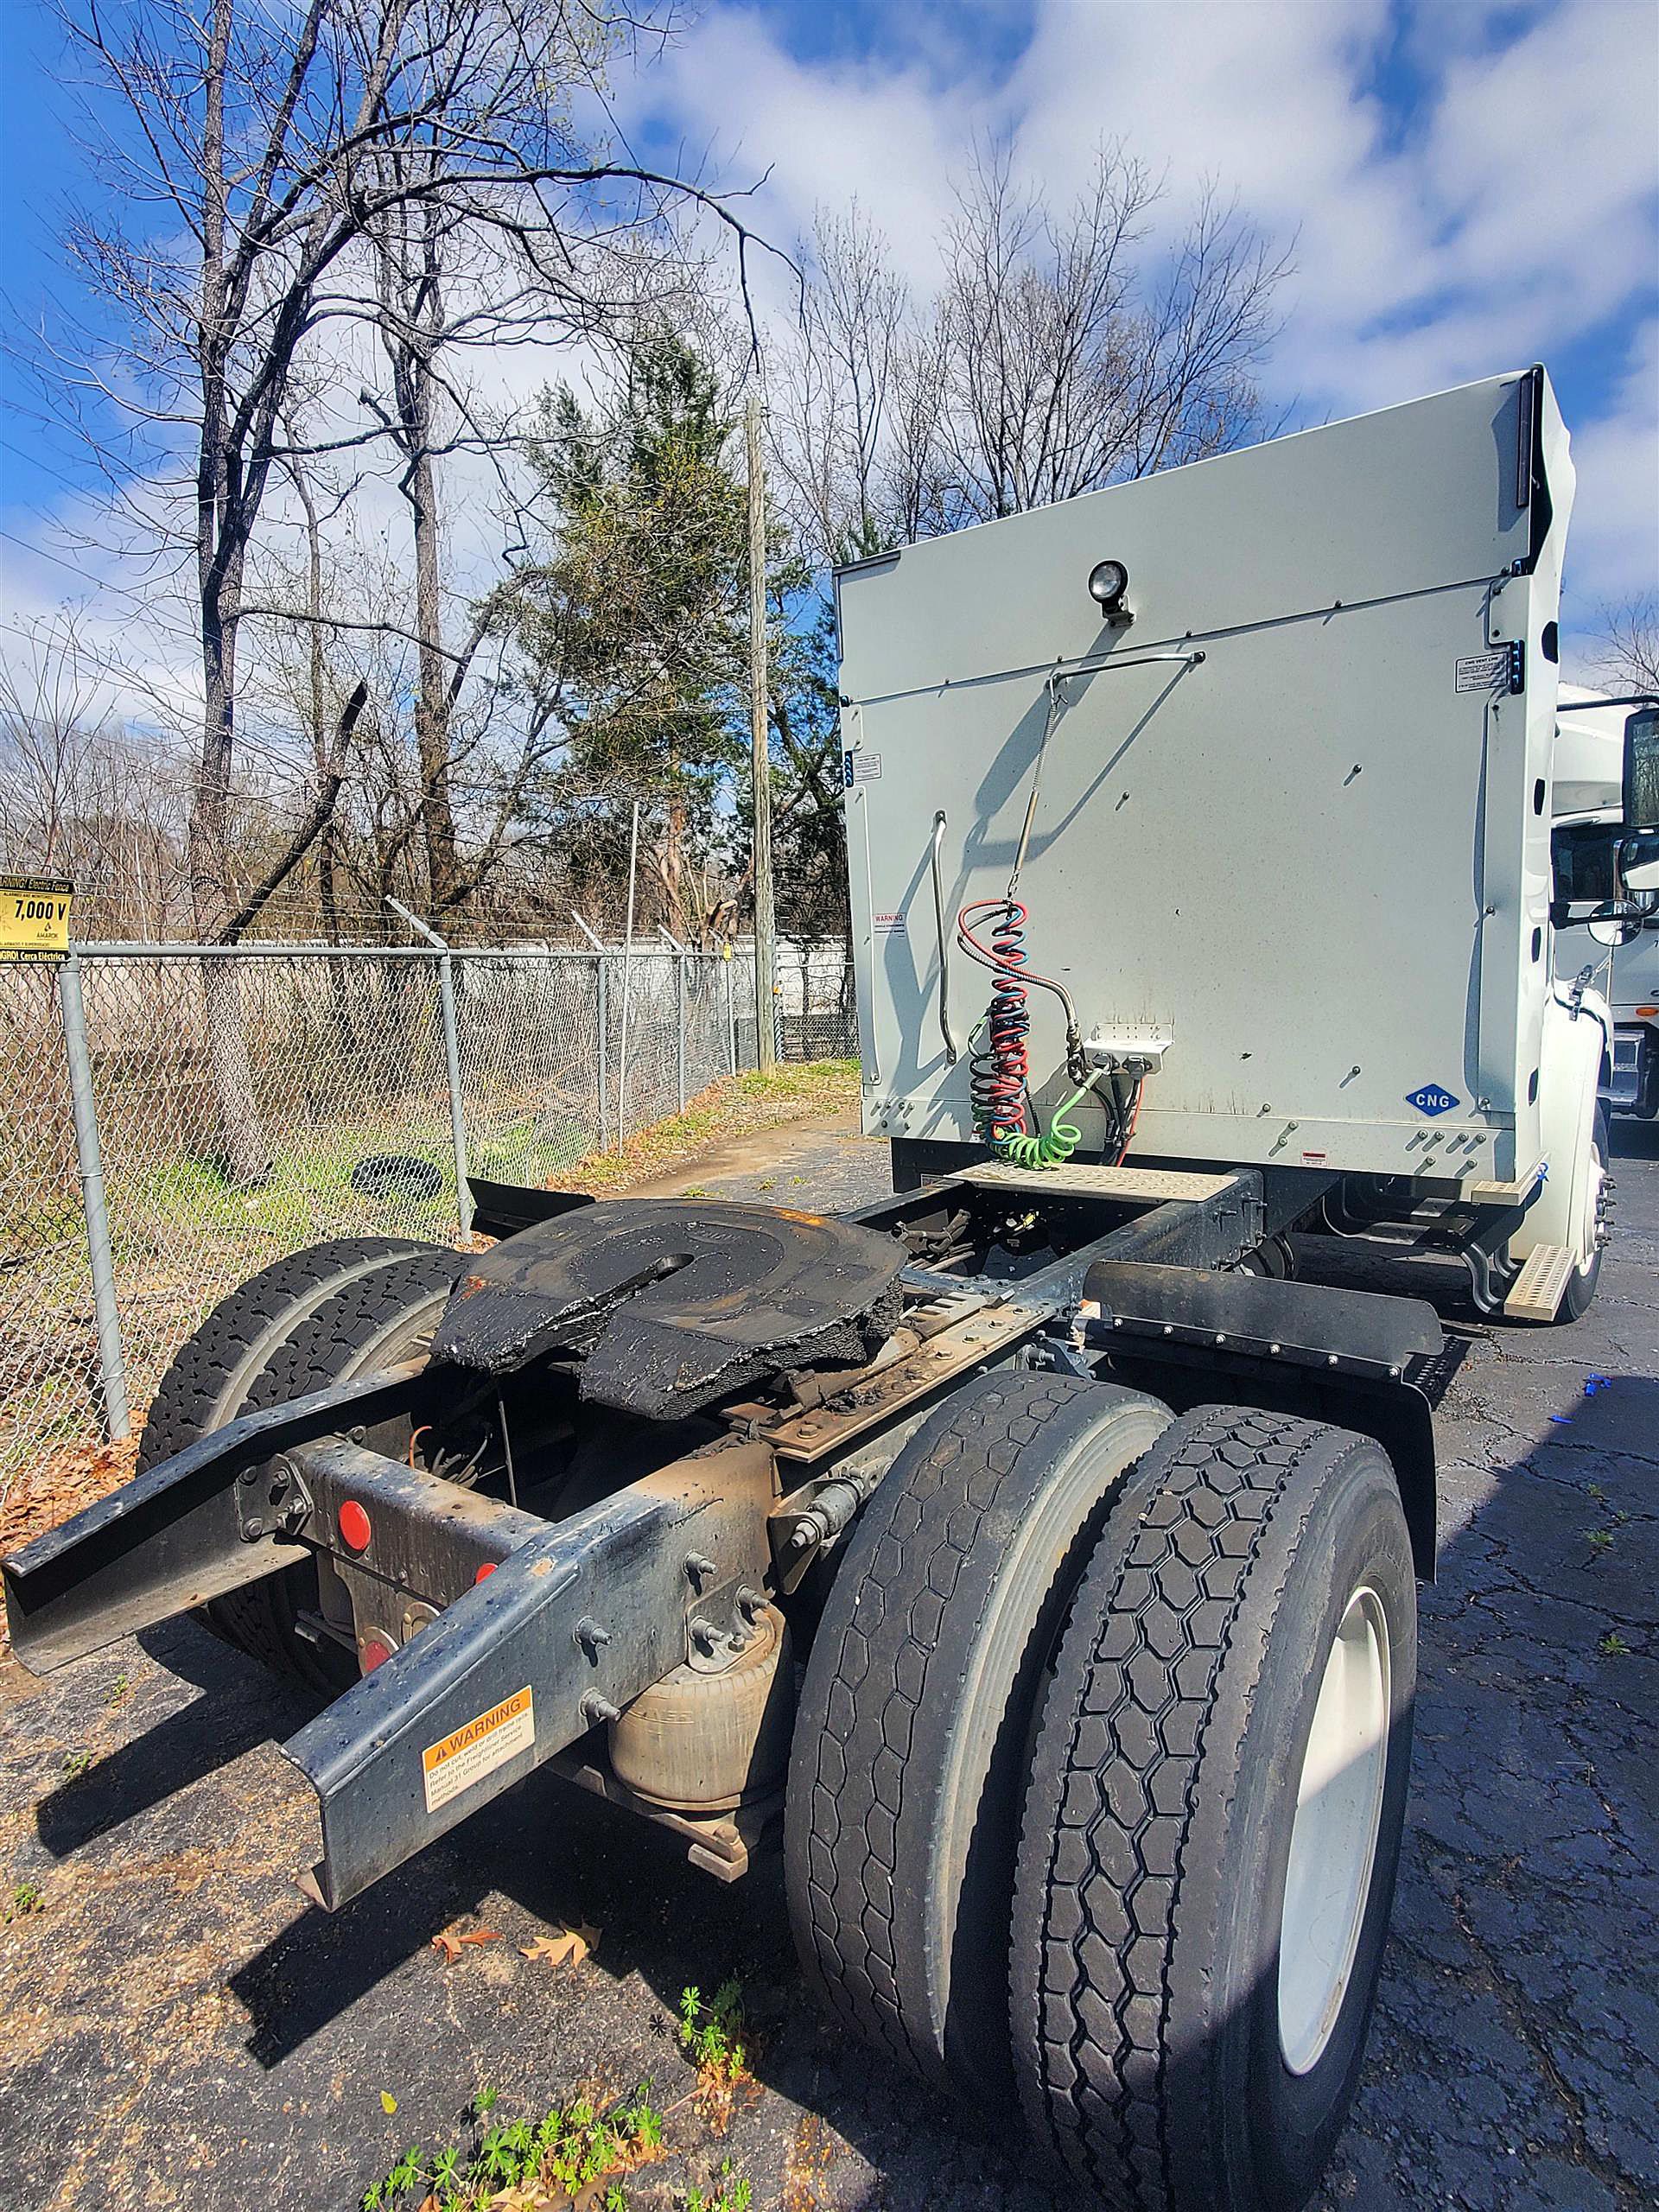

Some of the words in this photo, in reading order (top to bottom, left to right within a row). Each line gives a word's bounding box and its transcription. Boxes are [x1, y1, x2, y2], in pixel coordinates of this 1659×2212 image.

[29, 879, 51, 891] Electric
[51, 881, 69, 892] Fence
[16, 899, 54, 921] 7,000
[58, 903, 67, 920] V
[21, 951, 37, 961] Cerca
[1416, 1093, 1450, 1108] CNG
[449, 1698, 521, 1751] WARNING
[430, 1774, 447, 1788] Refer
[448, 1768, 455, 1777] to
[455, 1761, 466, 1771] the
[501, 1726, 521, 1741] Service
[431, 1778, 454, 1796] Manual
[463, 1760, 481, 1776] Group
[482, 1753, 491, 1763] for
[493, 1732, 523, 1756] attachment
[429, 1770, 439, 1779] Do
[440, 1762, 450, 1771] not
